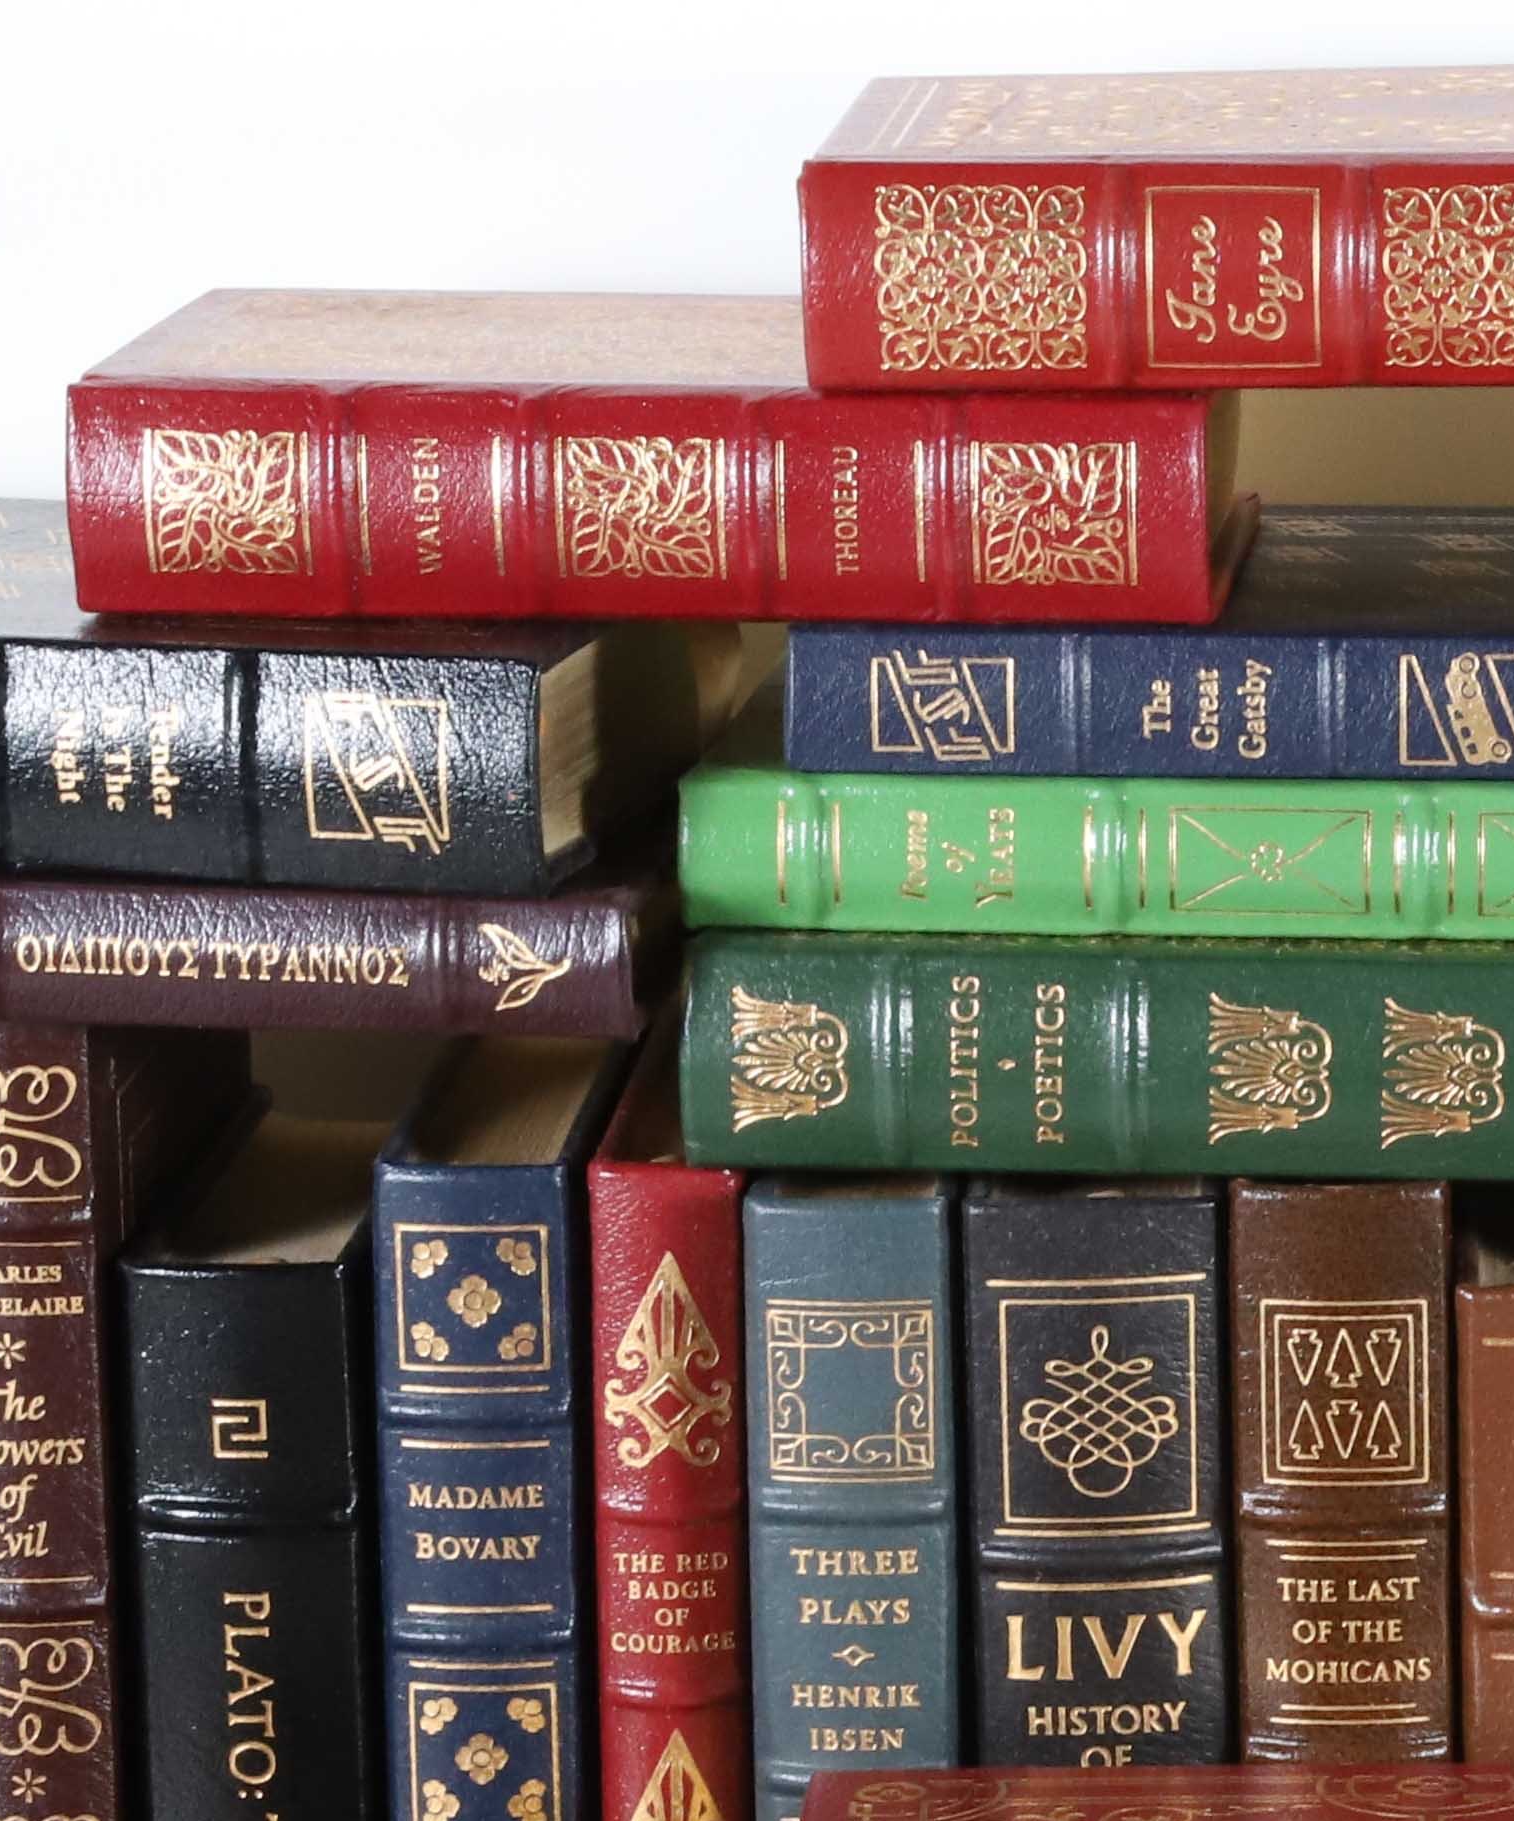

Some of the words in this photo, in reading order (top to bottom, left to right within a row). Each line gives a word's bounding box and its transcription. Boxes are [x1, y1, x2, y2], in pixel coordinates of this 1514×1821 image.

[1167, 214, 1218, 344] Jane
[1226, 214, 1304, 342] Eyre
[410, 436, 444, 575] WALDEN
[835, 444, 860, 577] THOREAU
[1142, 677, 1174, 739] The
[1190, 666, 1220, 751] Great
[1237, 658, 1273, 760] Gatsby
[148, 702, 181, 820] Tender
[900, 808, 929, 900] Poems
[975, 806, 1016, 909] YEATS
[950, 974, 982, 1149] POLITICS
[1036, 983, 1066, 1144] POETICS
[408, 1483, 545, 1510] MADAME
[414, 1532, 542, 1562] BOVARY
[675, 1551, 729, 1575] RED
[788, 1546, 919, 1577] THREE
[627, 1578, 717, 1602] BADGE
[797, 1598, 911, 1626] PLAYS
[1347, 1575, 1422, 1604] LAST
[609, 1630, 736, 1656] COURAGE
[1005, 1608, 1208, 1682] LIVY
[1264, 1657, 1433, 1686] MOHICANS
[223, 1590, 278, 1801] PLATO:
[790, 1683, 921, 1709] HENRIK
[1026, 1701, 1188, 1736] HISTORY
[808, 1728, 905, 1752] IBSEN
